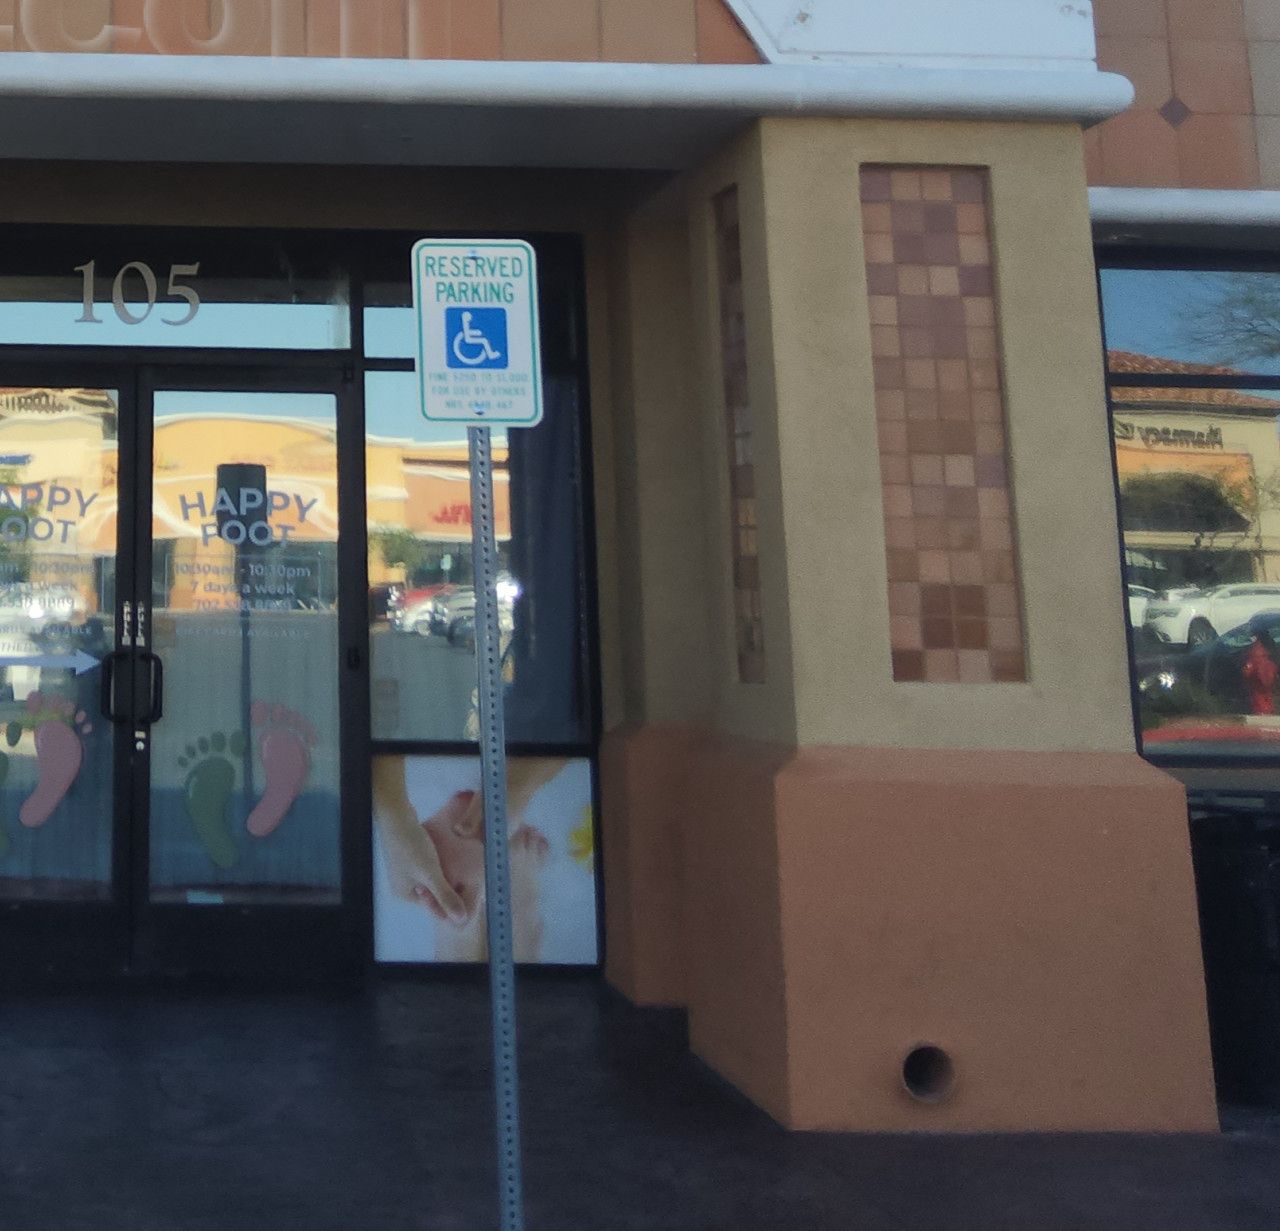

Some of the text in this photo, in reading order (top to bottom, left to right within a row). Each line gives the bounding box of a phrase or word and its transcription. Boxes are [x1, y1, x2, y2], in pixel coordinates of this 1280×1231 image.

[424, 255, 523, 278] RESERVED
[73, 259, 201, 326] 105
[435, 281, 514, 303] PARKING
[178, 487, 318, 523] HAPPY
[201, 519, 296, 547] FOOT
[255, 581, 296, 595] week
